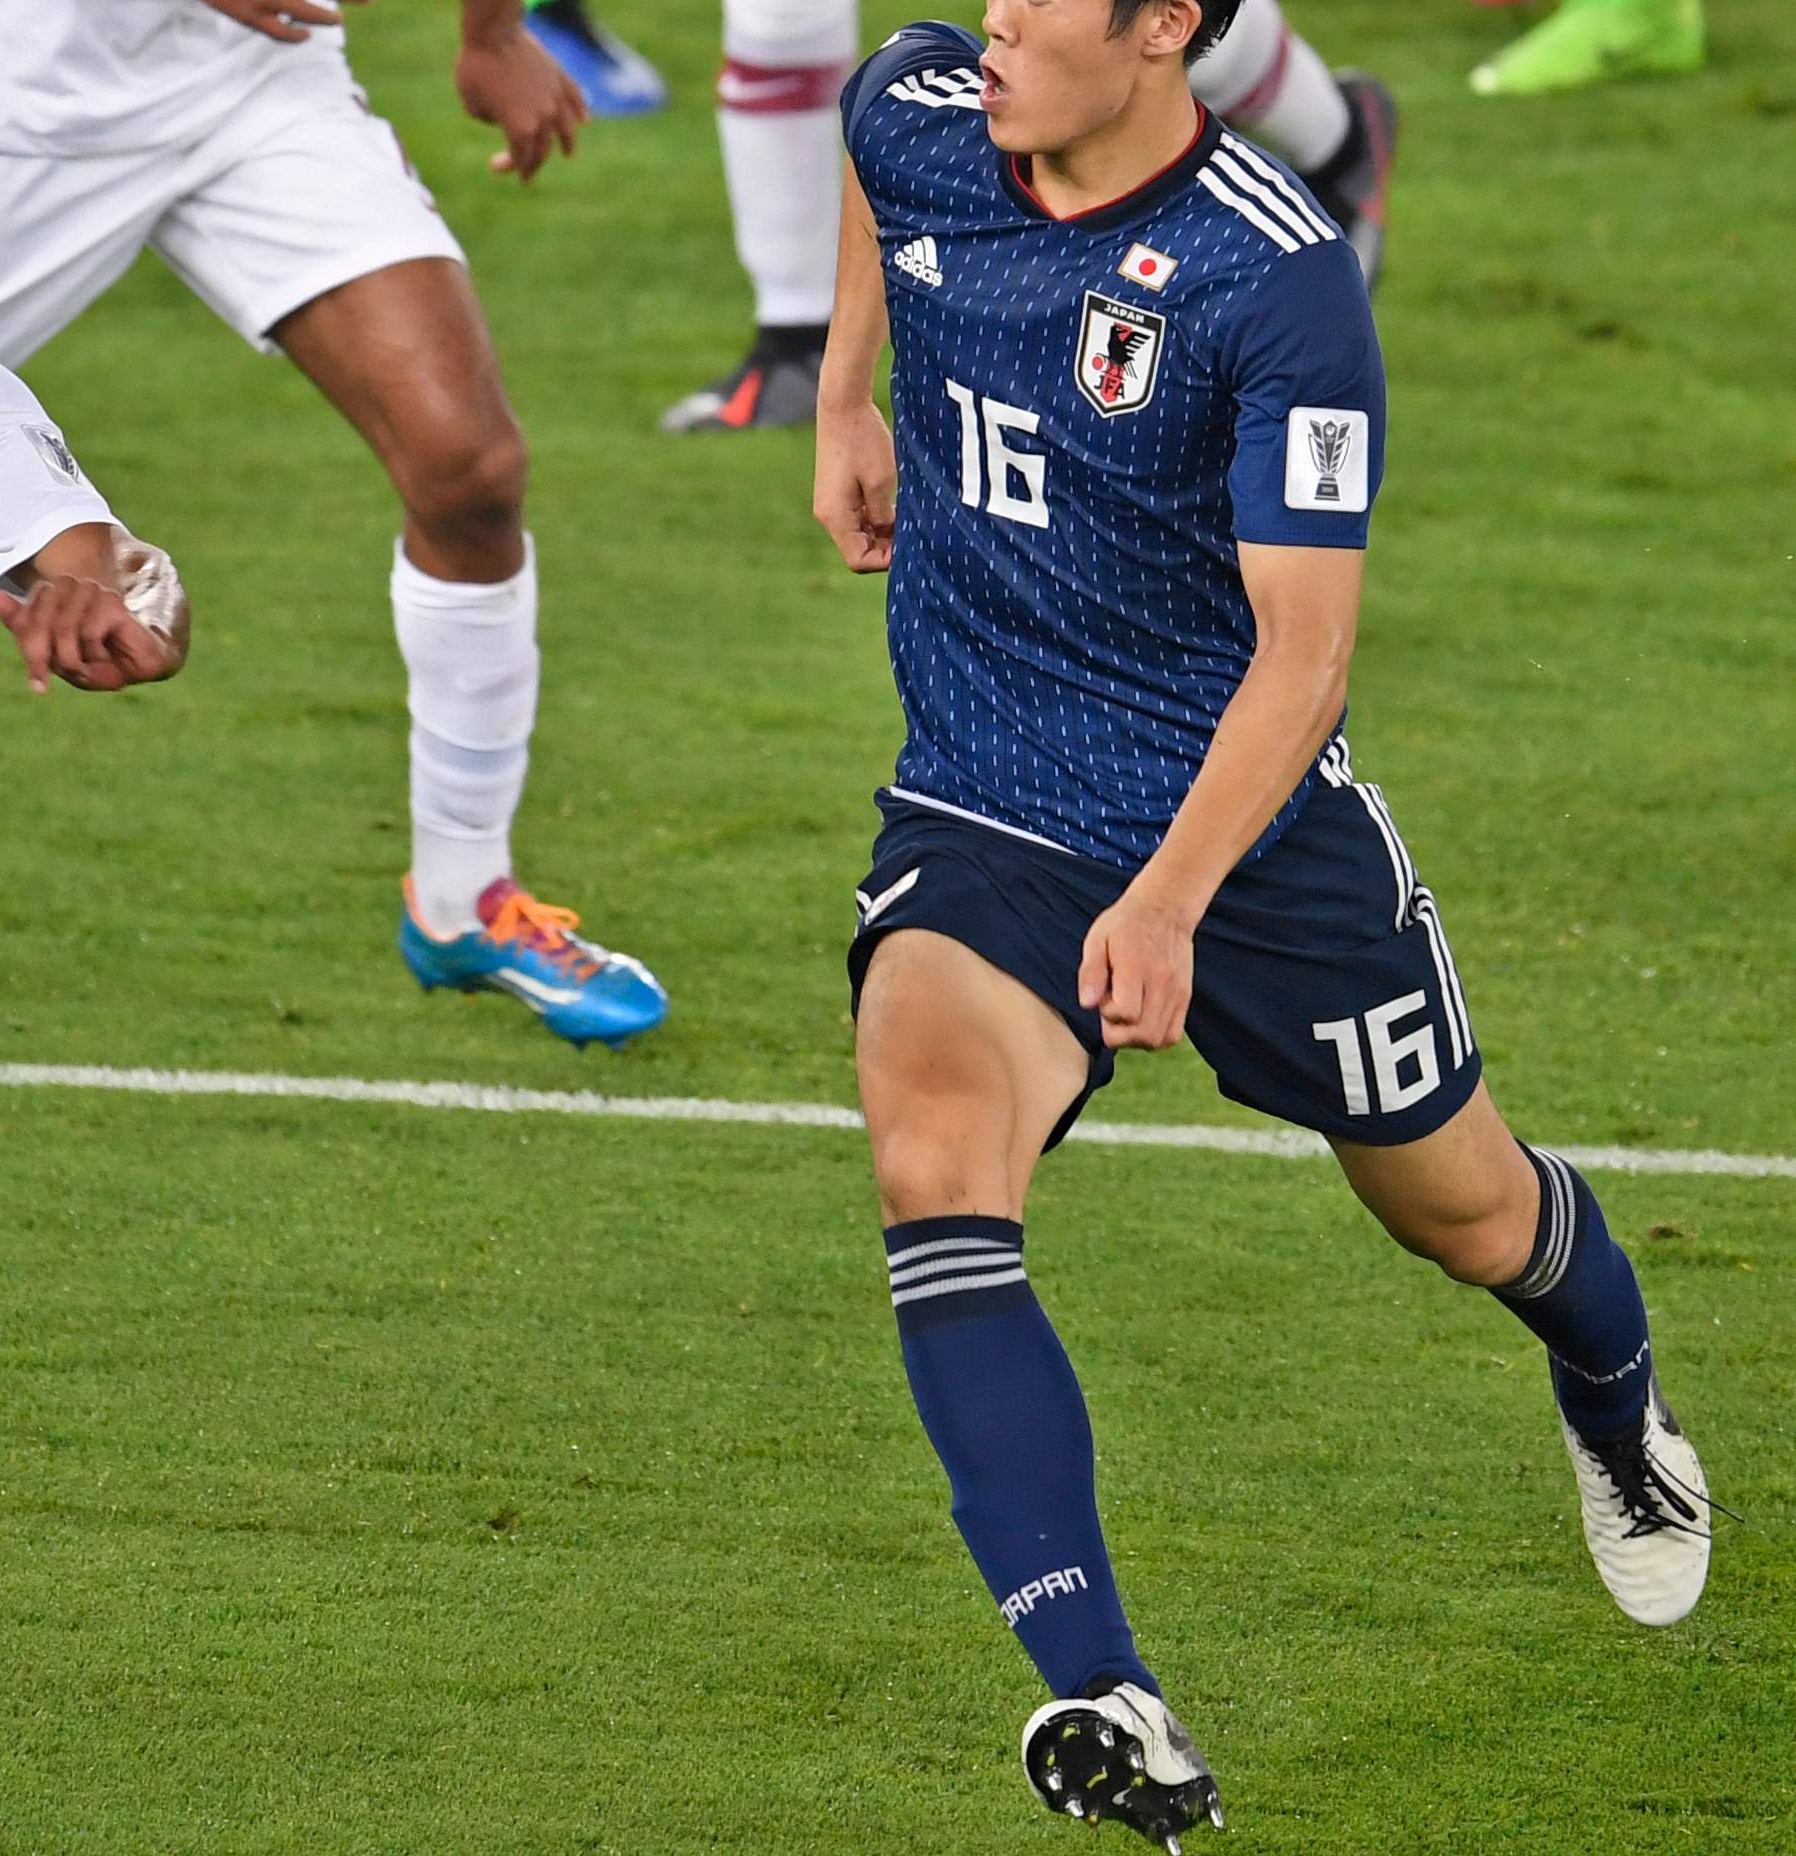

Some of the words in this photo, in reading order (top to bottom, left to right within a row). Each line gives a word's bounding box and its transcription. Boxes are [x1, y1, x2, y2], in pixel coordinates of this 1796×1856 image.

[894, 250, 943, 287] adidas
[1104, 303, 1145, 324] JAPAN
[1093, 375, 1125, 400] JFA
[945, 377, 1050, 529] 16
[1312, 988, 1441, 1116] 16
